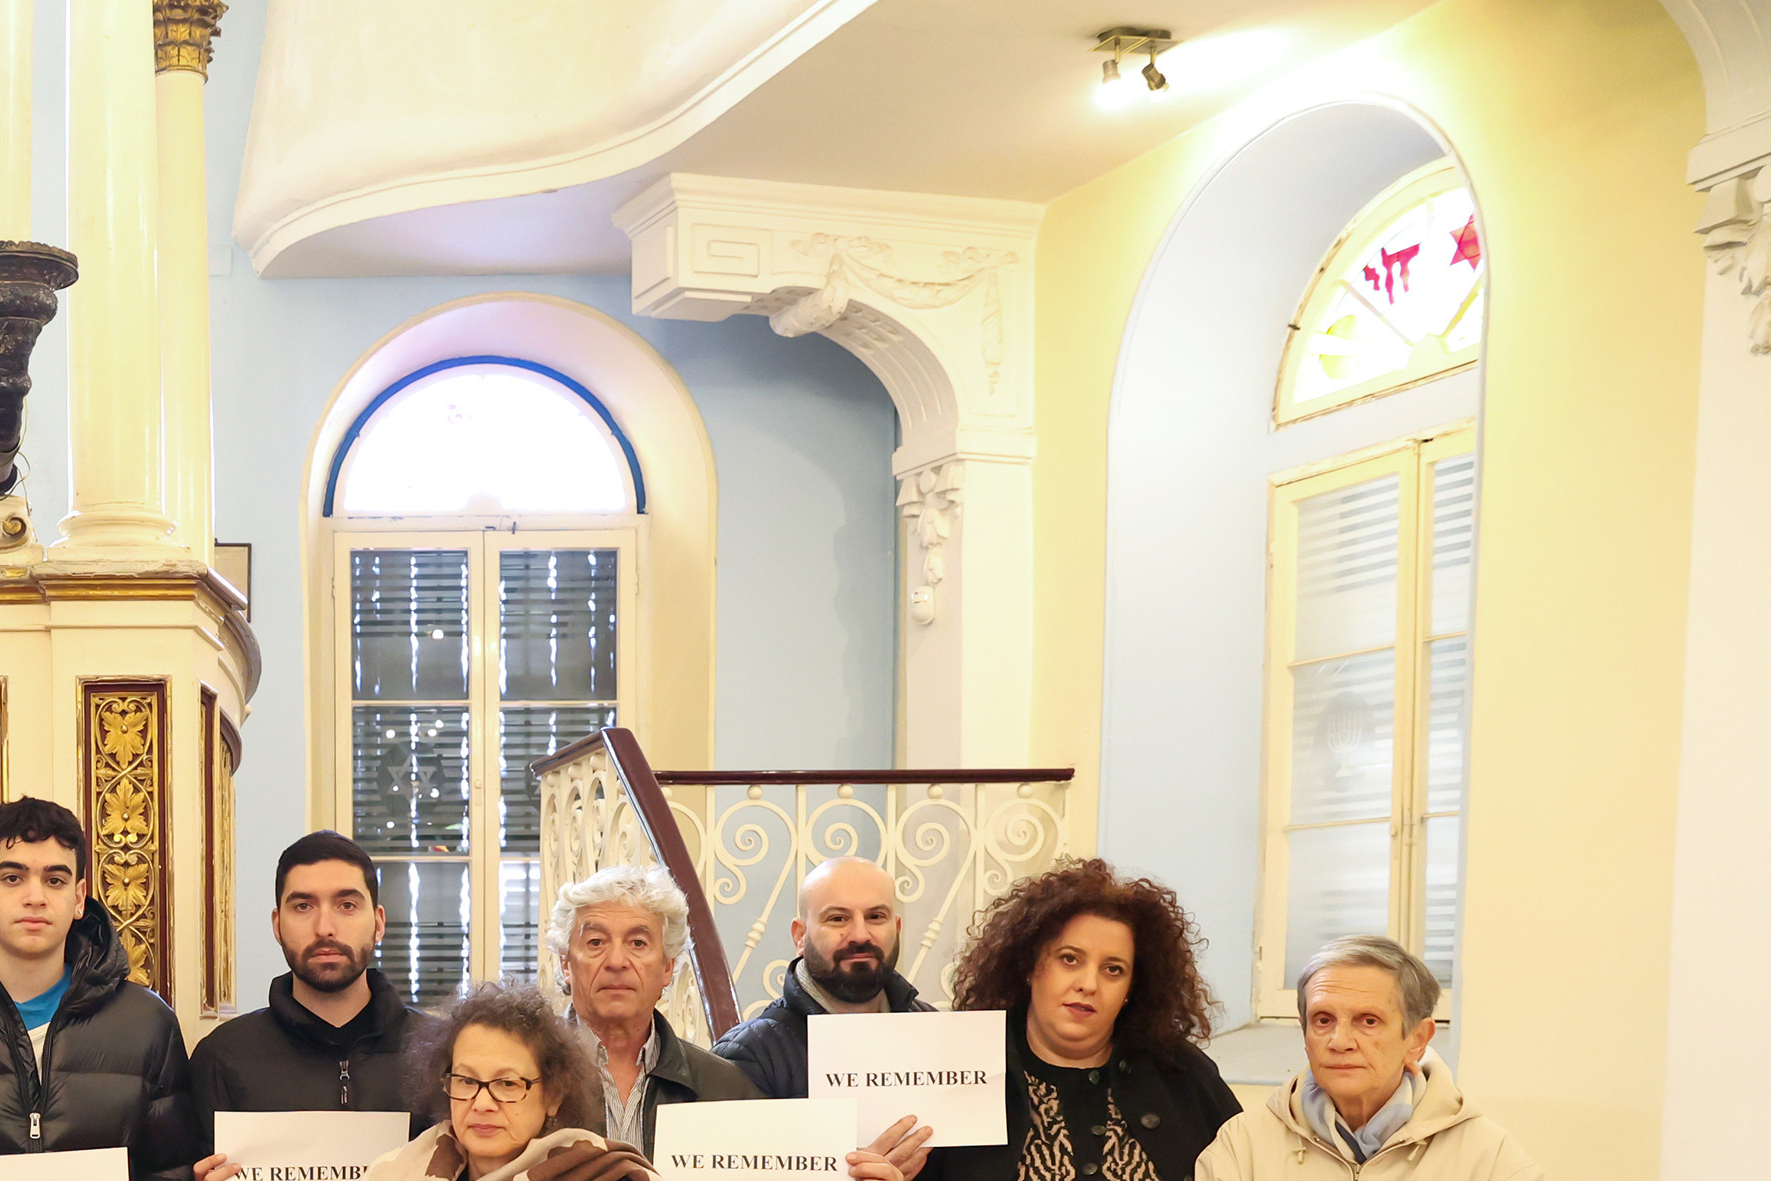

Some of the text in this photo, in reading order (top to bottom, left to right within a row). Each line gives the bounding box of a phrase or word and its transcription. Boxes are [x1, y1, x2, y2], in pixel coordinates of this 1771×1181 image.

[826, 1071, 987, 1087] WE REMEMBER
[671, 1155, 838, 1171] WE REMEMBER
[235, 1165, 369, 1181] WE REMEMB
